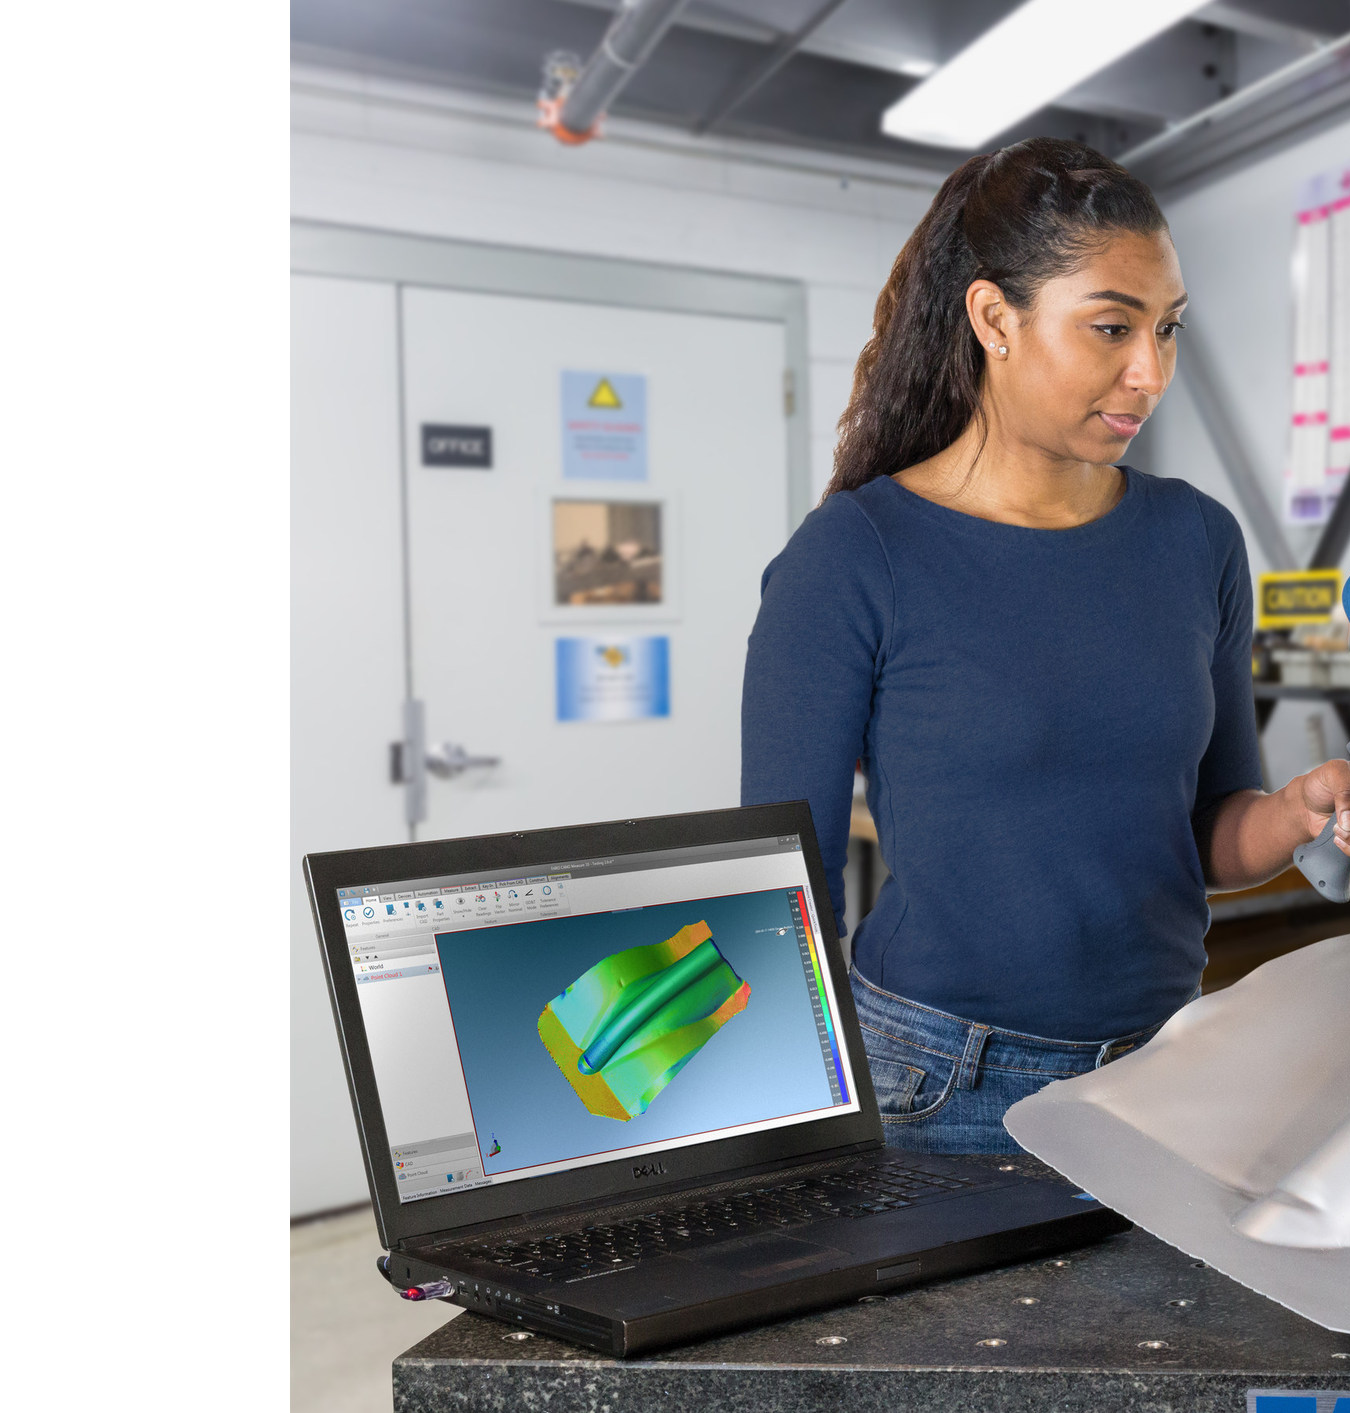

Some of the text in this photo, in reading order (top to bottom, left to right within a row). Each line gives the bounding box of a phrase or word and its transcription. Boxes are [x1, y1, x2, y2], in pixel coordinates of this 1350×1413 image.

[428, 438, 483, 455] OFFICE
[1266, 587, 1332, 610] CAUTION
[369, 963, 384, 971] World
[632, 1162, 667, 1179] DELL
[416, 1190, 437, 1198] Information
[440, 1185, 464, 1193] Measurement
